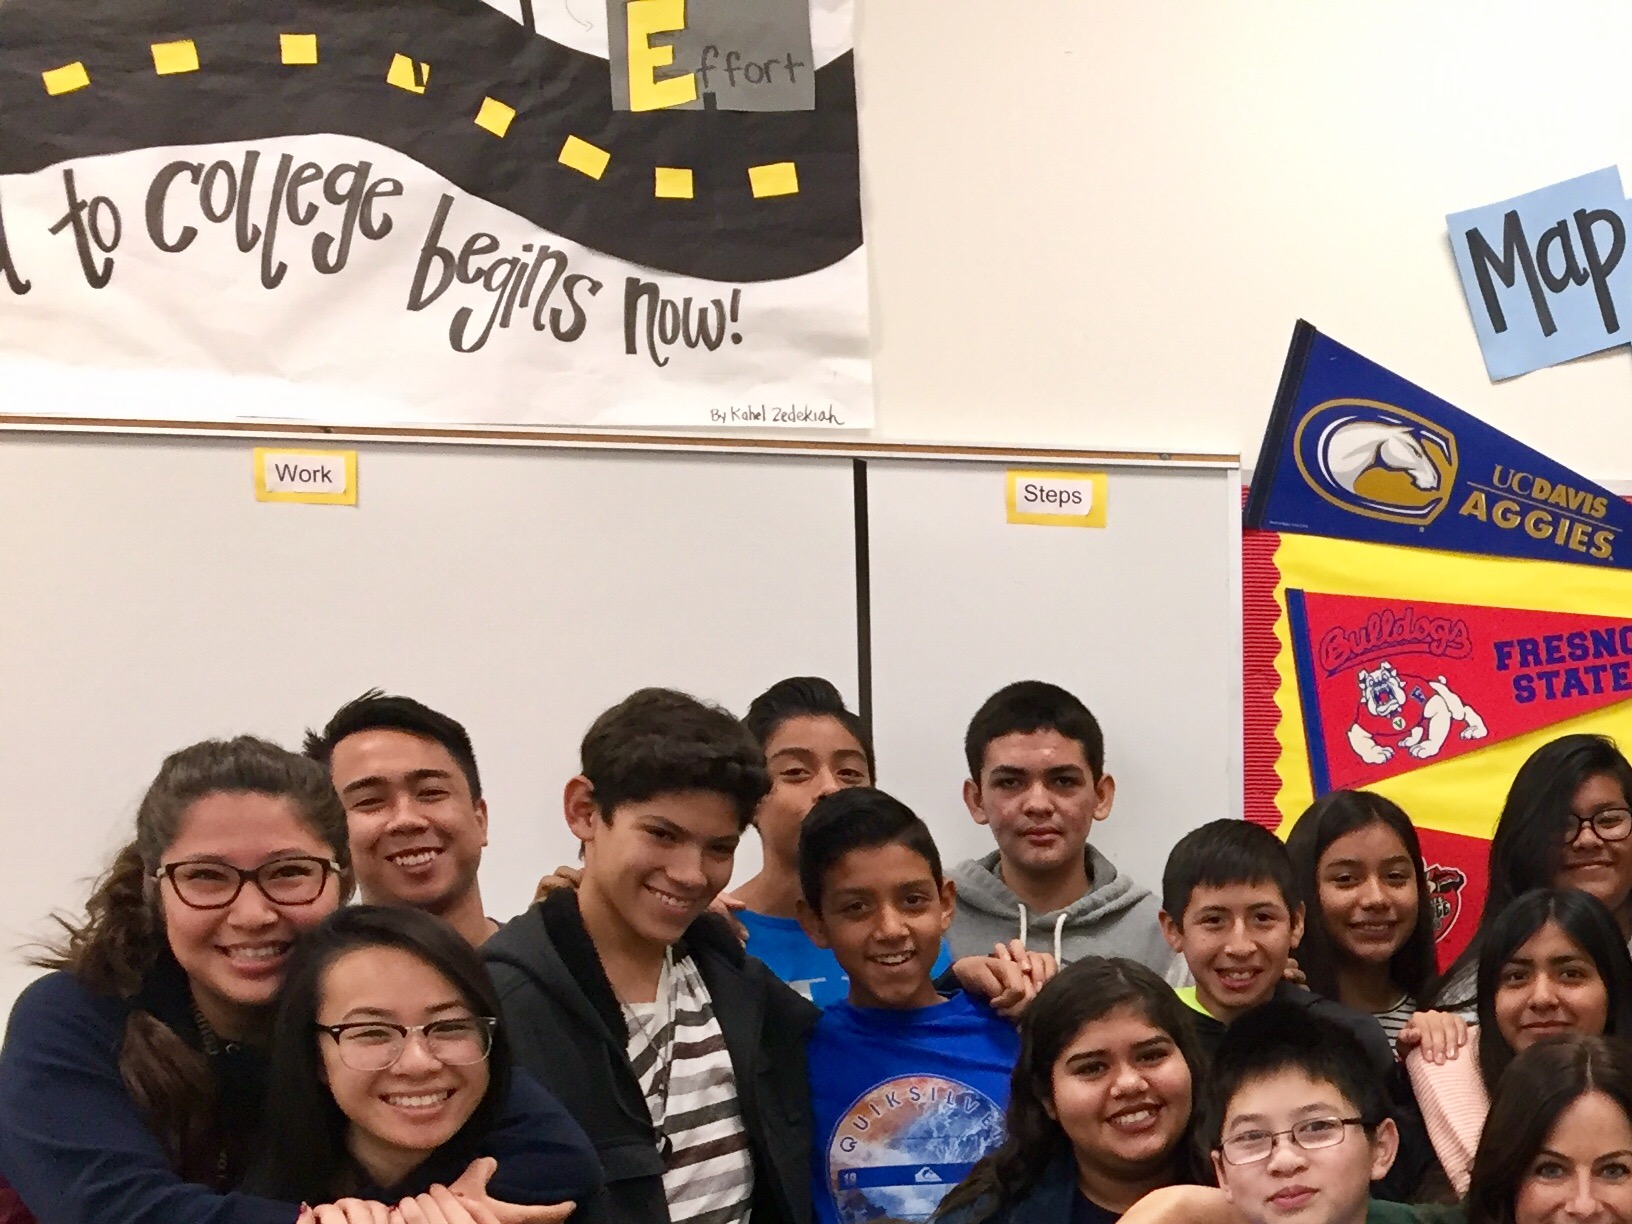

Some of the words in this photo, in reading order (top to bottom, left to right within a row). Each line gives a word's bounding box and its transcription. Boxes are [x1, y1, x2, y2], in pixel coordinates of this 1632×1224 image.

[626, 0, 805, 112] Effort
[48, 168, 122, 290] to
[406, 193, 604, 354] begins
[1465, 208, 1626, 337] Map
[710, 408, 727, 424] By
[274, 463, 333, 484] Work
[1023, 483, 1083, 508] Steps
[1458, 491, 1616, 560] AGGIES
[1319, 607, 1473, 674] Bulldogs
